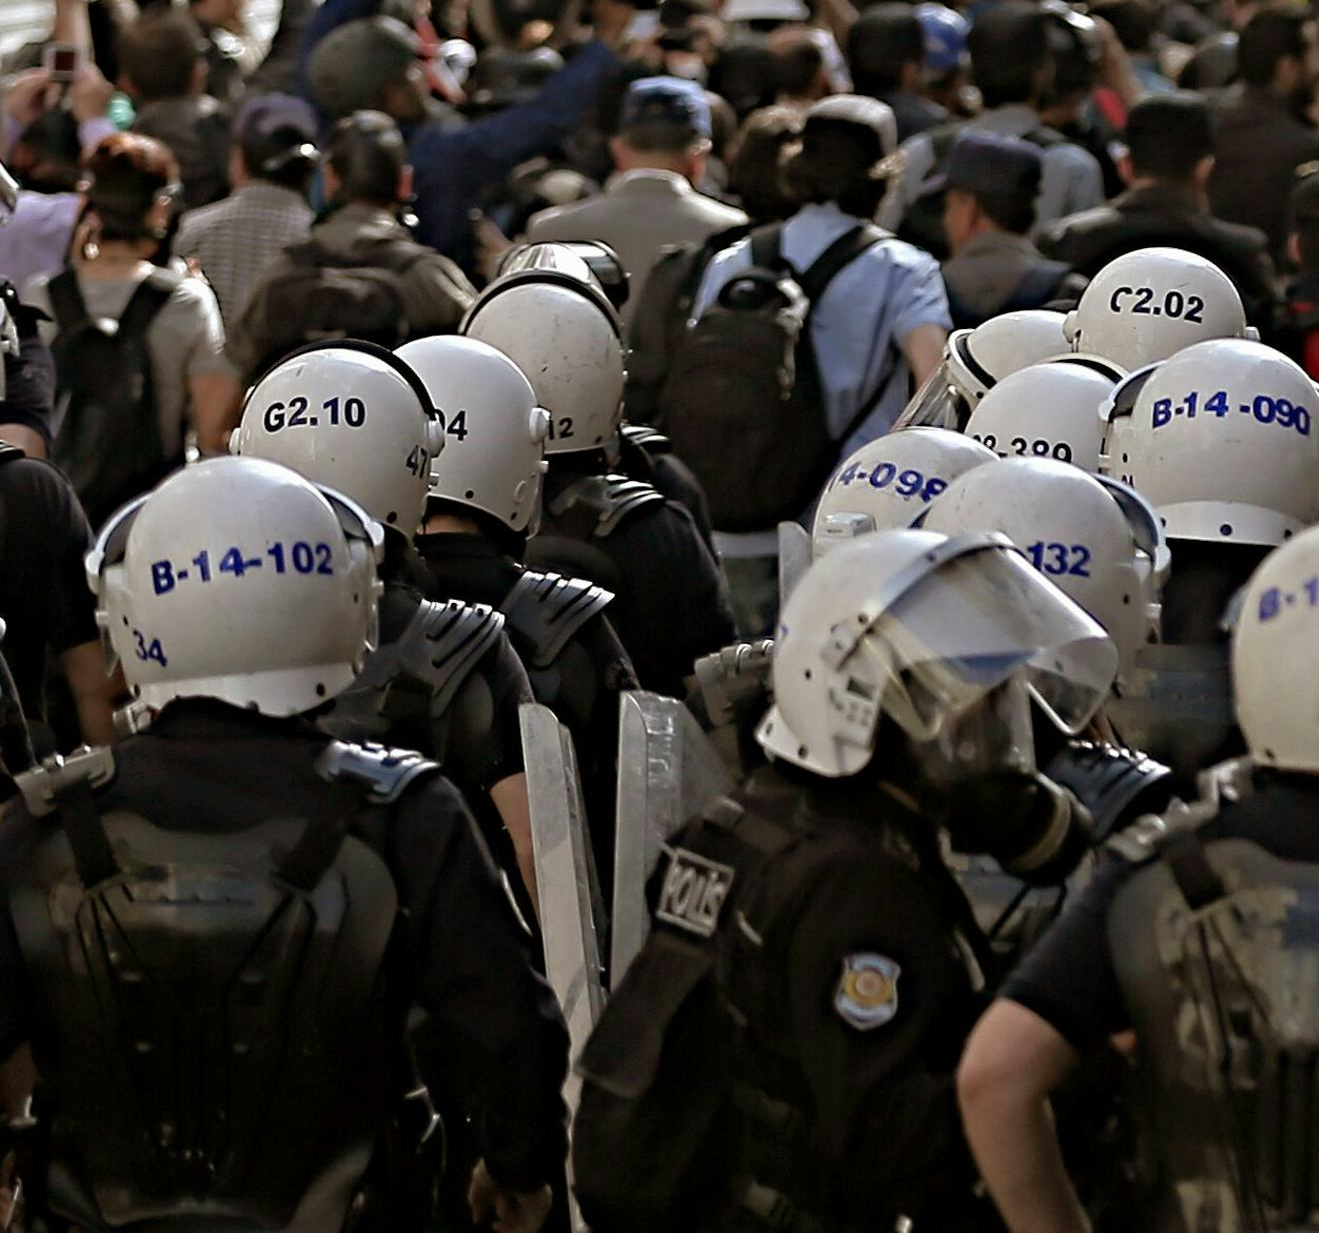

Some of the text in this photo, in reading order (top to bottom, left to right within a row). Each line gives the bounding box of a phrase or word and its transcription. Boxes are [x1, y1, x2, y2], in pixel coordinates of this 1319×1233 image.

[264, 396, 366, 434] G2.10
[151, 540, 334, 596] B-14-102
[133, 627, 167, 667] 34
